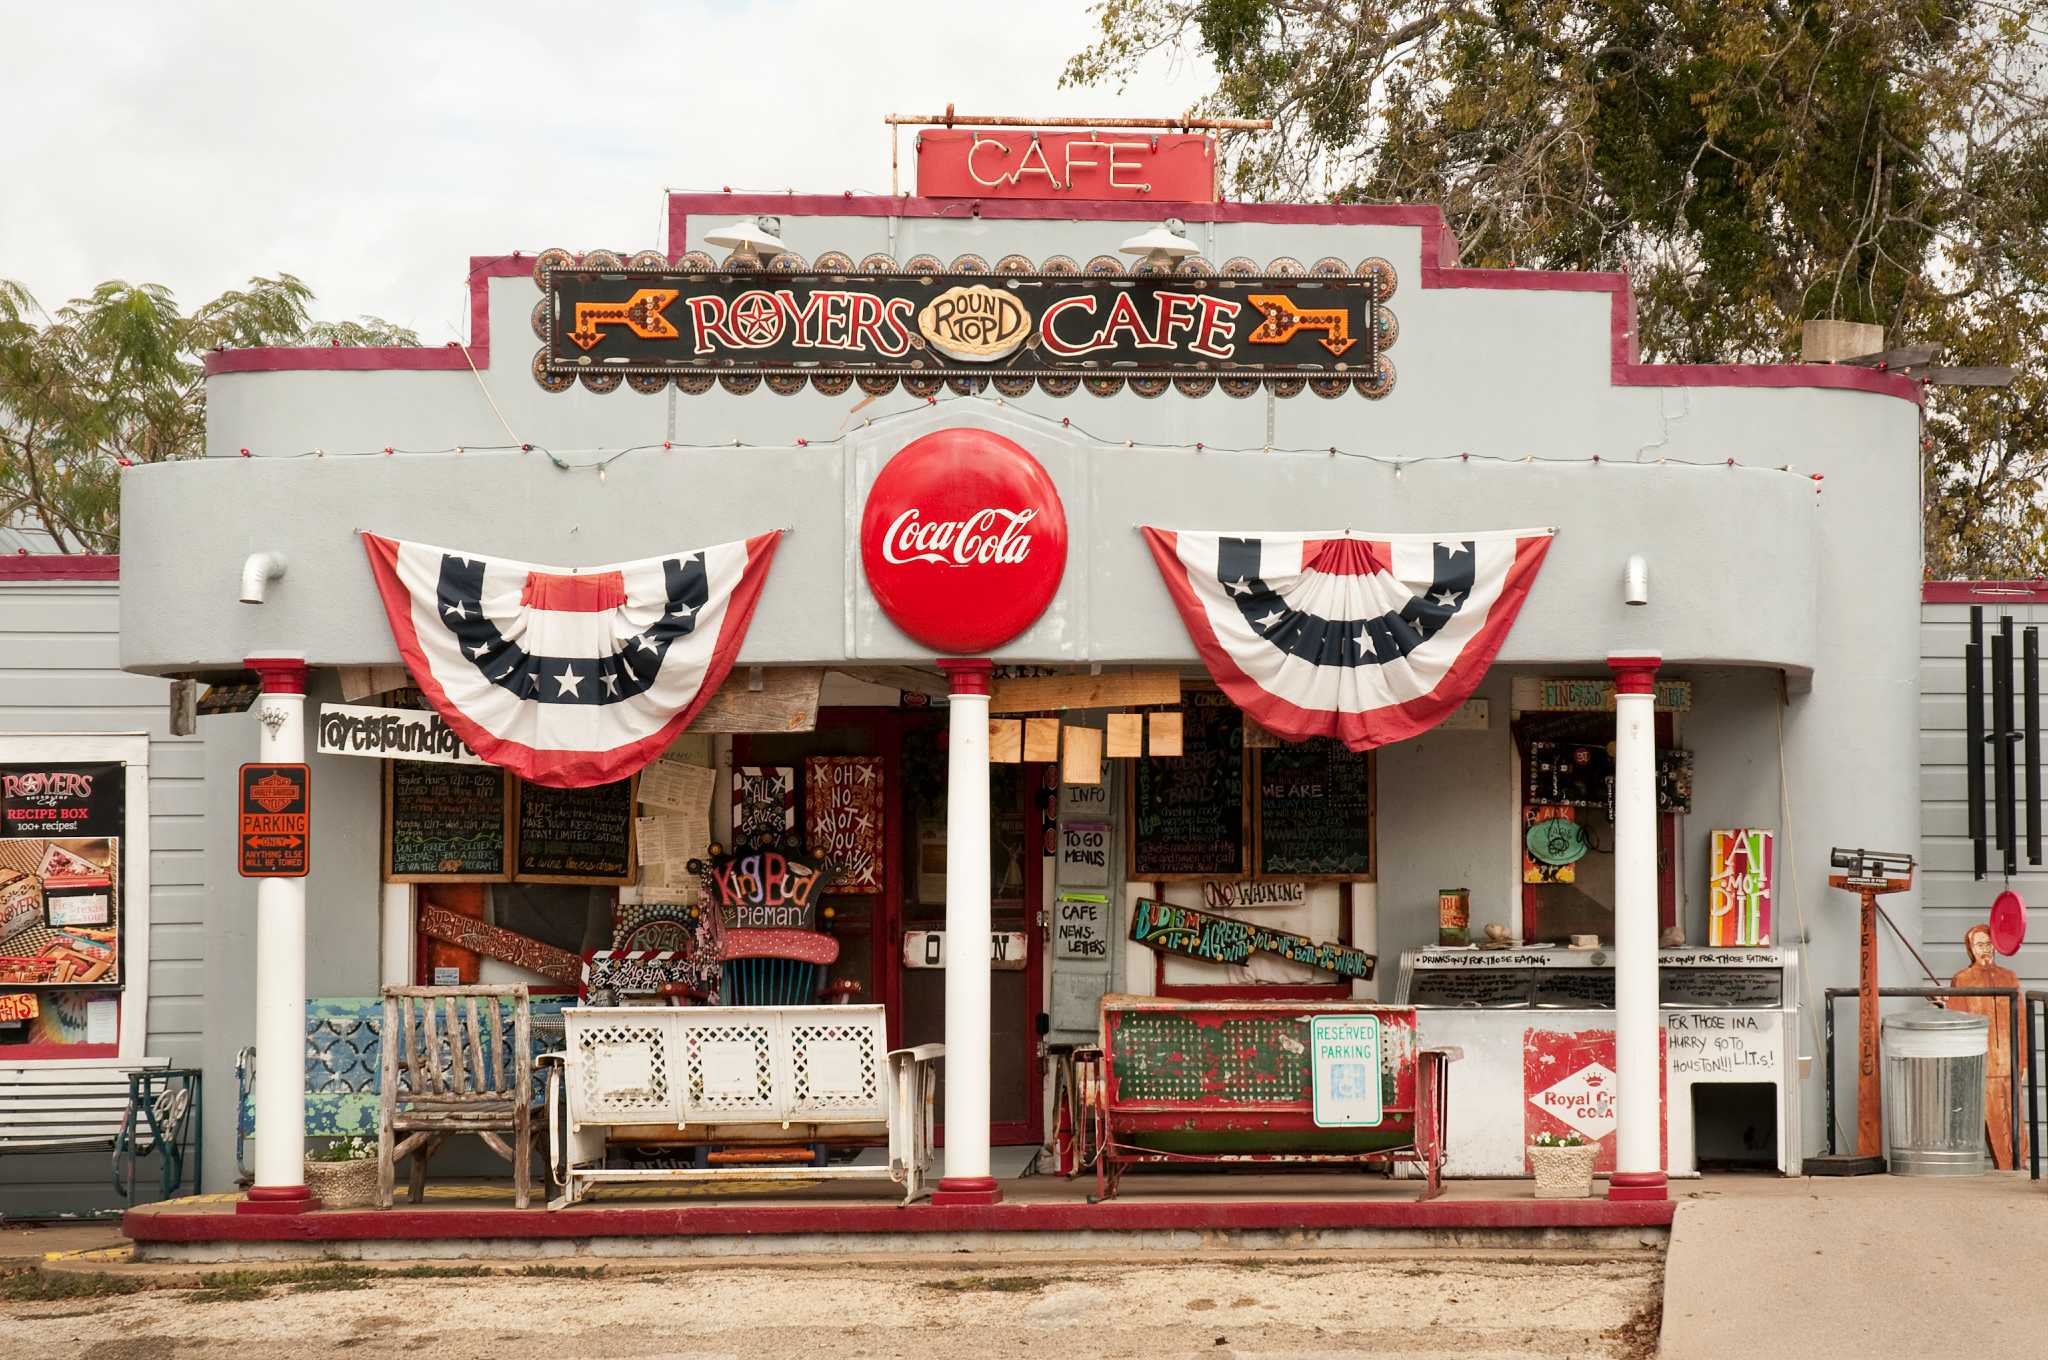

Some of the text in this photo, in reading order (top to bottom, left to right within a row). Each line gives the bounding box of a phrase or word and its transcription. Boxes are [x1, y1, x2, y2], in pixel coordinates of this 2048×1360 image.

[968, 139, 1151, 189] CAFE
[686, 289, 914, 357] ROYERS
[934, 293, 1021, 338] ROUND
[1040, 291, 1242, 358] CAFE
[954, 316, 998, 345] TOP
[882, 508, 1040, 564] Coca-Cola
[2, 772, 93, 798] ROYERS
[833, 765, 853, 786] OH
[752, 779, 774, 804] ALL
[831, 788, 851, 808] NO
[1070, 787, 1105, 802] INFO
[1263, 784, 1324, 799] WE ARE
[7, 808, 88, 820] RECIPE BOX
[742, 810, 786, 836] SERVICES
[823, 807, 859, 835] NOT
[17, 821, 77, 832] 100+ recipes!
[243, 815, 305, 833] PARKING
[824, 832, 855, 854] YOU
[1063, 831, 1103, 848] TO GO
[1065, 850, 1105, 866] MENUS
[1711, 828, 1774, 882] EAT
[1206, 881, 1303, 908] NO WHINING
[1062, 906, 1097, 921] CAFE
[1711, 886, 1770, 946] PIE
[1068, 940, 1105, 957] LETTERS
[1469, 955, 1486, 965] FOR
[1514, 954, 1546, 966] EATING
[1699, 954, 1714, 963] FOR
[1715, 953, 1745, 964] THOSE
[1746, 954, 1774, 964] EATING
[1668, 1013, 1759, 1030] FOR THOSE IN A
[1317, 1026, 1374, 1040] RESERVED
[1322, 1045, 1371, 1059] PARKING
[1669, 1035, 1744, 1054] HURRY GO TO
[1544, 1091, 1590, 1109] Royal
